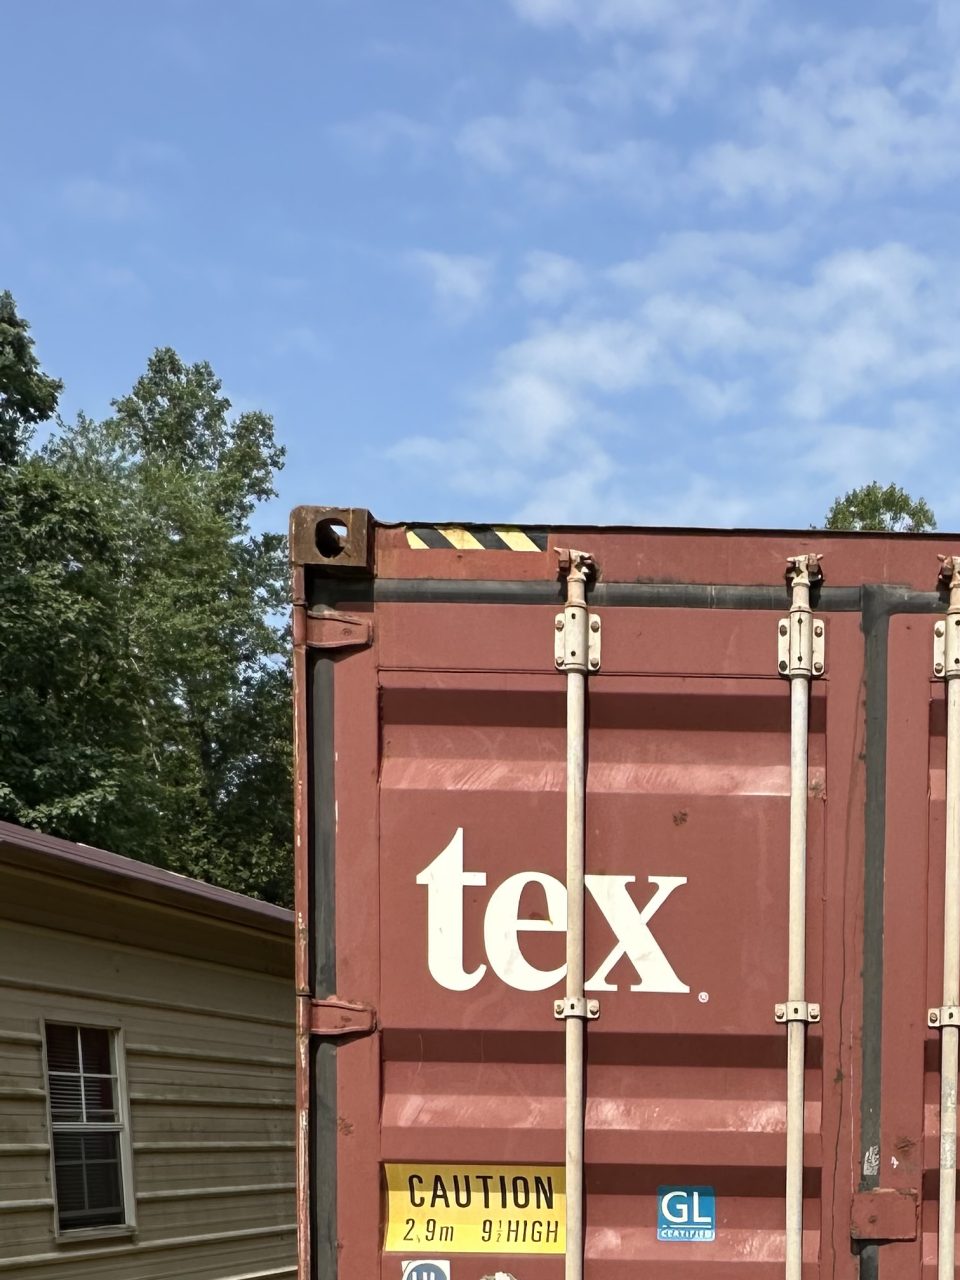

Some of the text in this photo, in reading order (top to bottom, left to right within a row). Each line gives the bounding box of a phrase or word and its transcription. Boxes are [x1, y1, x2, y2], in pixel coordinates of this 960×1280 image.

[416, 827, 690, 993] tex
[408, 1174, 554, 1210] CAUTION
[661, 1190, 712, 1223] GL
